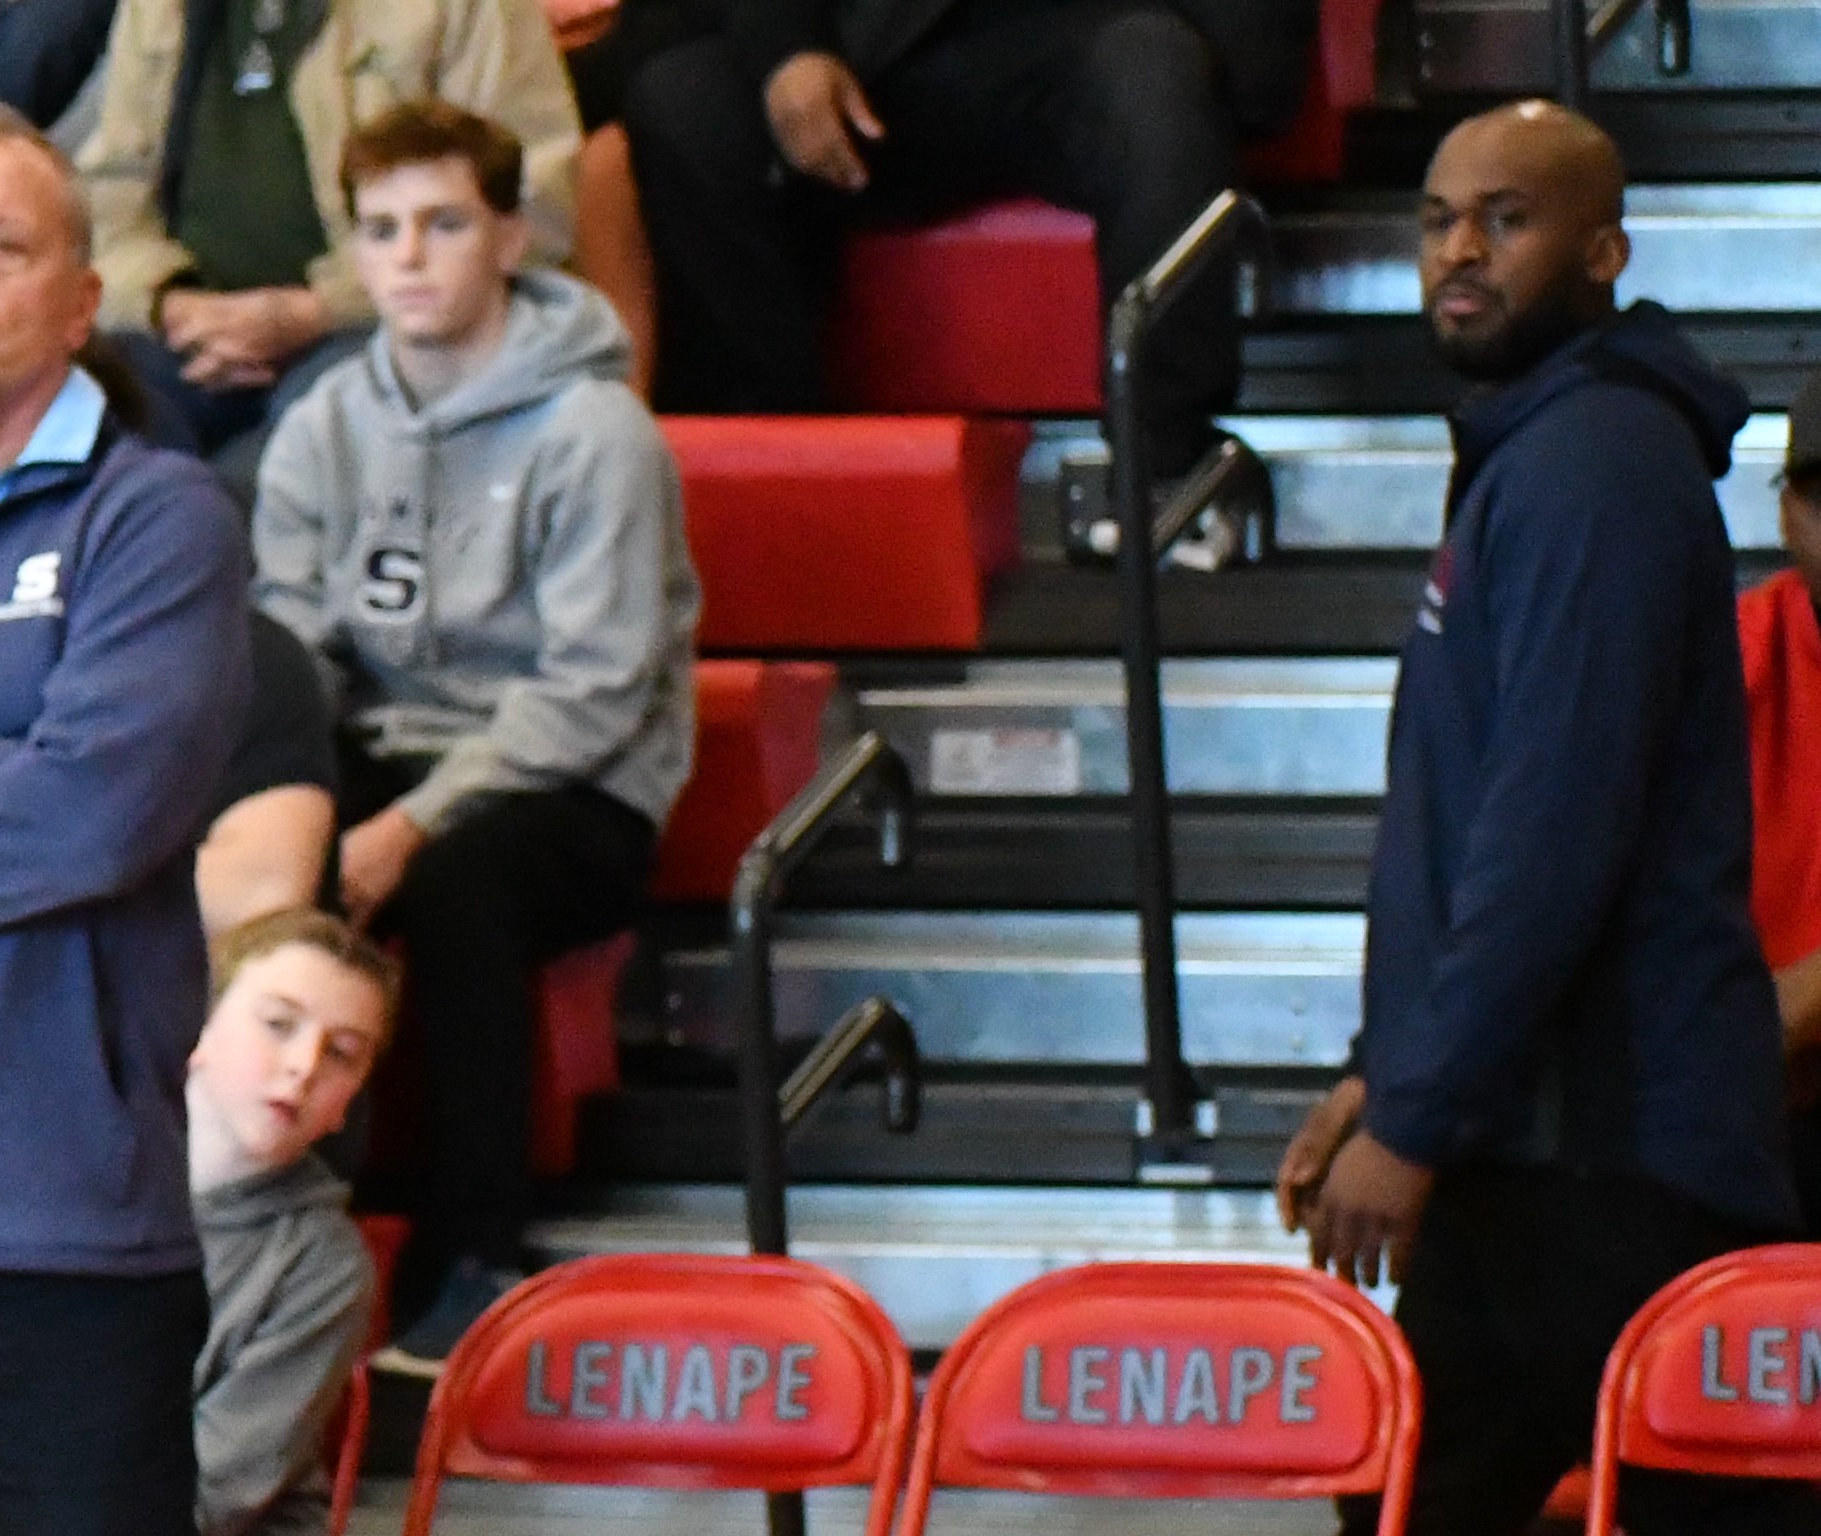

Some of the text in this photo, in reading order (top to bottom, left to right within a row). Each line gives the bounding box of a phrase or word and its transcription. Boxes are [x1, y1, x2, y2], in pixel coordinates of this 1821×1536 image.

[368, 547, 420, 613] S
[525, 1338, 818, 1422] LENAPE
[1021, 1342, 1324, 1425] LENAPE
